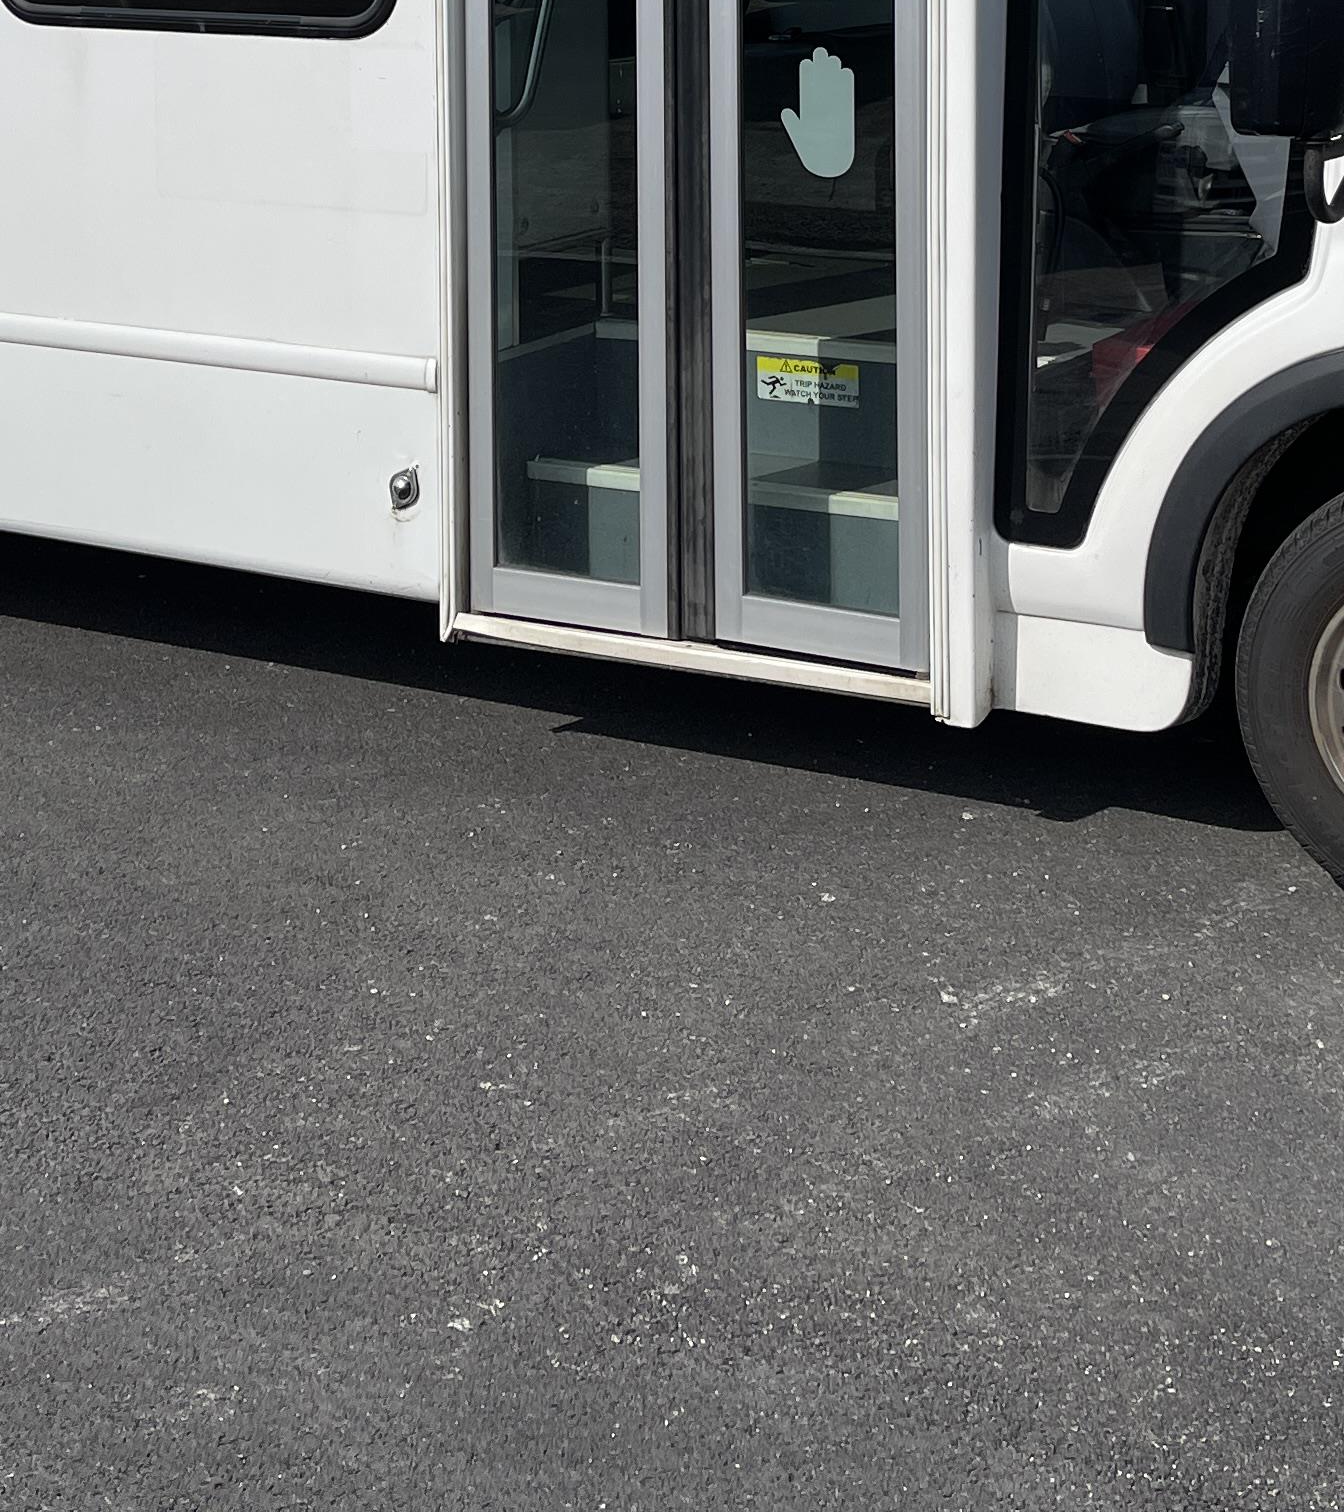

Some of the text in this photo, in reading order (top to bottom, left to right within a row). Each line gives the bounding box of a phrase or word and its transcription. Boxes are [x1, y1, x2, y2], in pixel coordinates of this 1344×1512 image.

[795, 379, 847, 392] TRIP HAZARD
[784, 389, 860, 403] WATCH YOUR STEP
